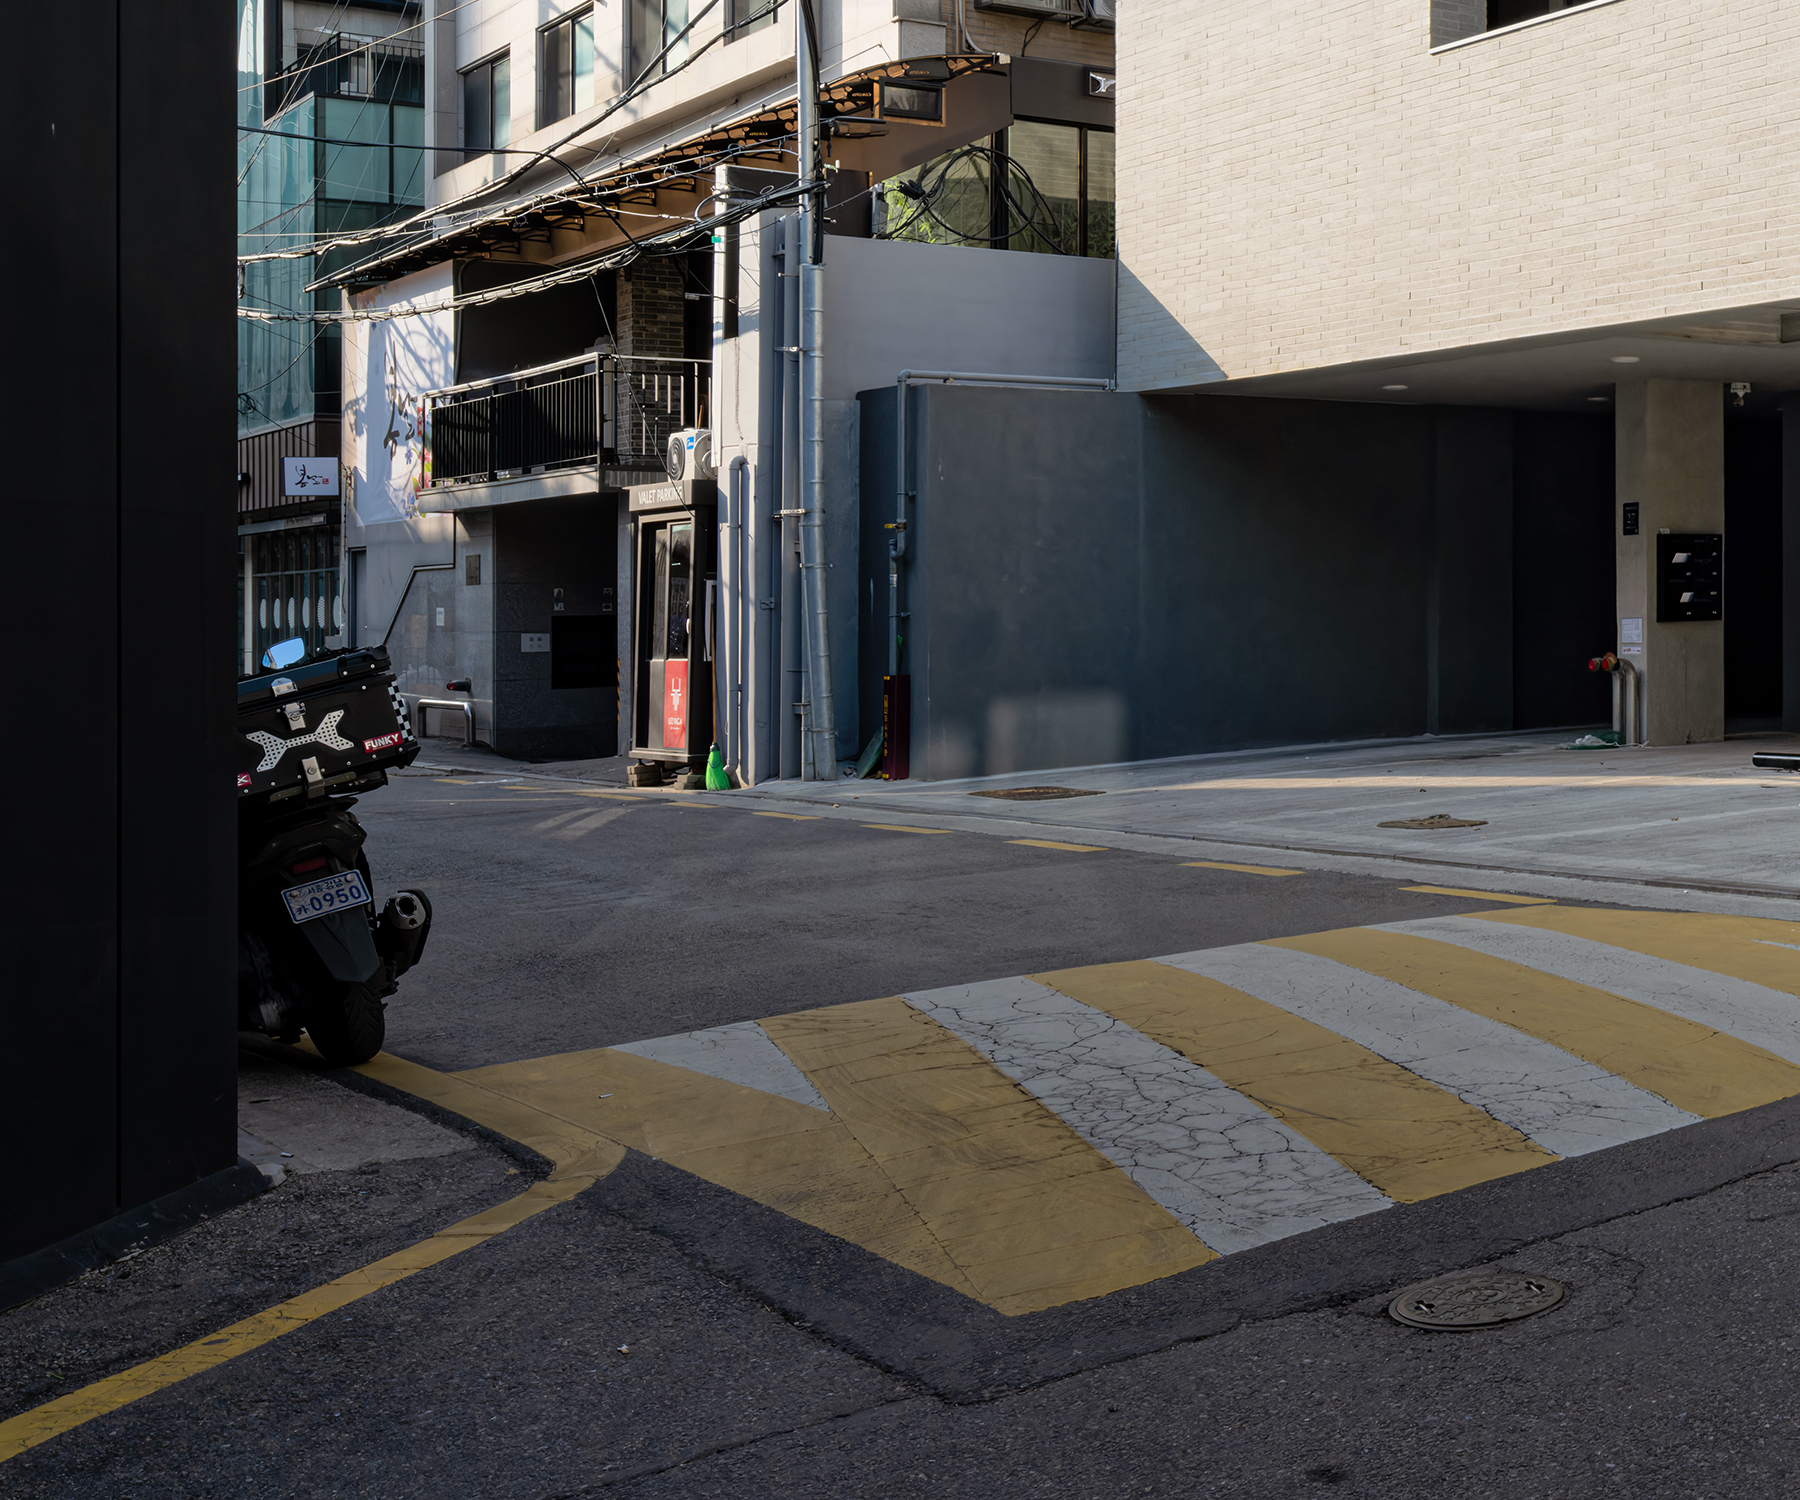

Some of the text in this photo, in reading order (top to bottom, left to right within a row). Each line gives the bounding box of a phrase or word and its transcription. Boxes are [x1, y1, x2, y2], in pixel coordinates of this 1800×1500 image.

[638, 486, 683, 505] VALET PARKING
[364, 733, 399, 750] FUNKY
